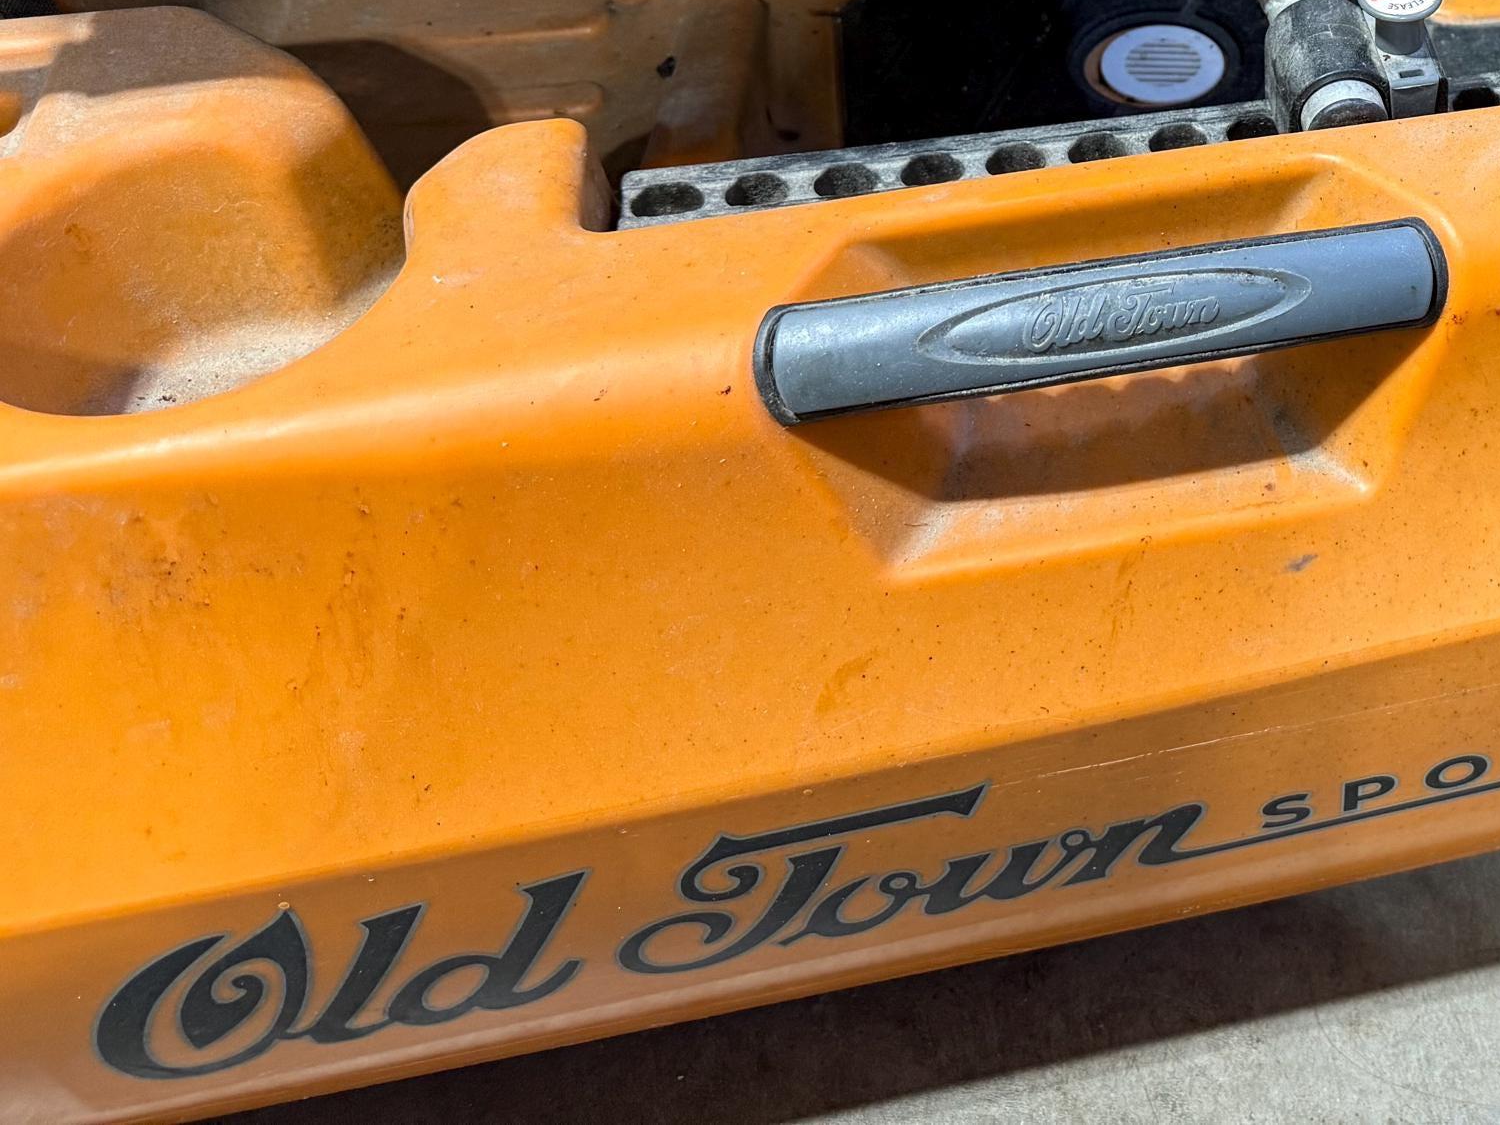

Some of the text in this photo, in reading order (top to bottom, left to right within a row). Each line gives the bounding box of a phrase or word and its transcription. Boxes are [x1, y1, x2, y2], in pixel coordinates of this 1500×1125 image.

[1023, 282, 1220, 353] Old Town
[93, 867, 592, 1080] Old
[617, 781, 1206, 975] Town
